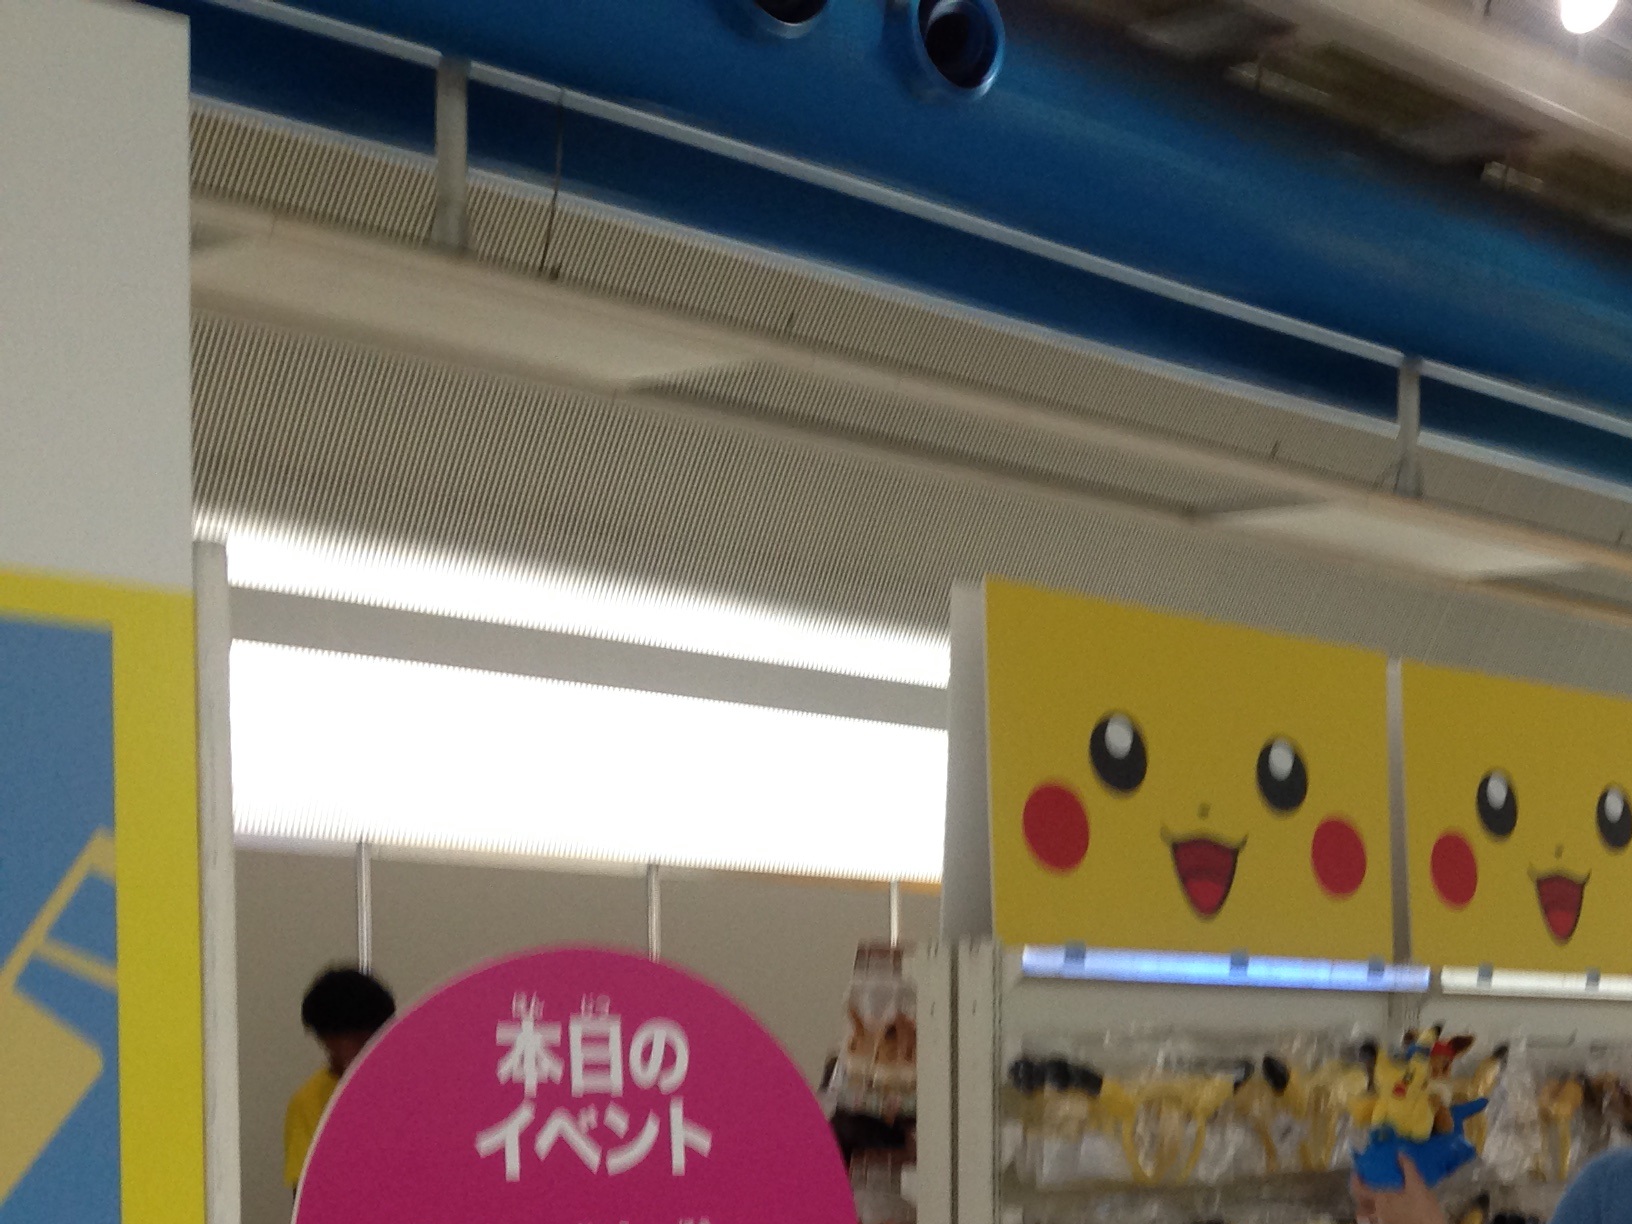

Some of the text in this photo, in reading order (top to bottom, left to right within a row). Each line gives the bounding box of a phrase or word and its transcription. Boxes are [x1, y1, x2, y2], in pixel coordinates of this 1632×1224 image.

[496, 1010, 690, 1098] 本日の
[474, 1096, 712, 1182] イベント
